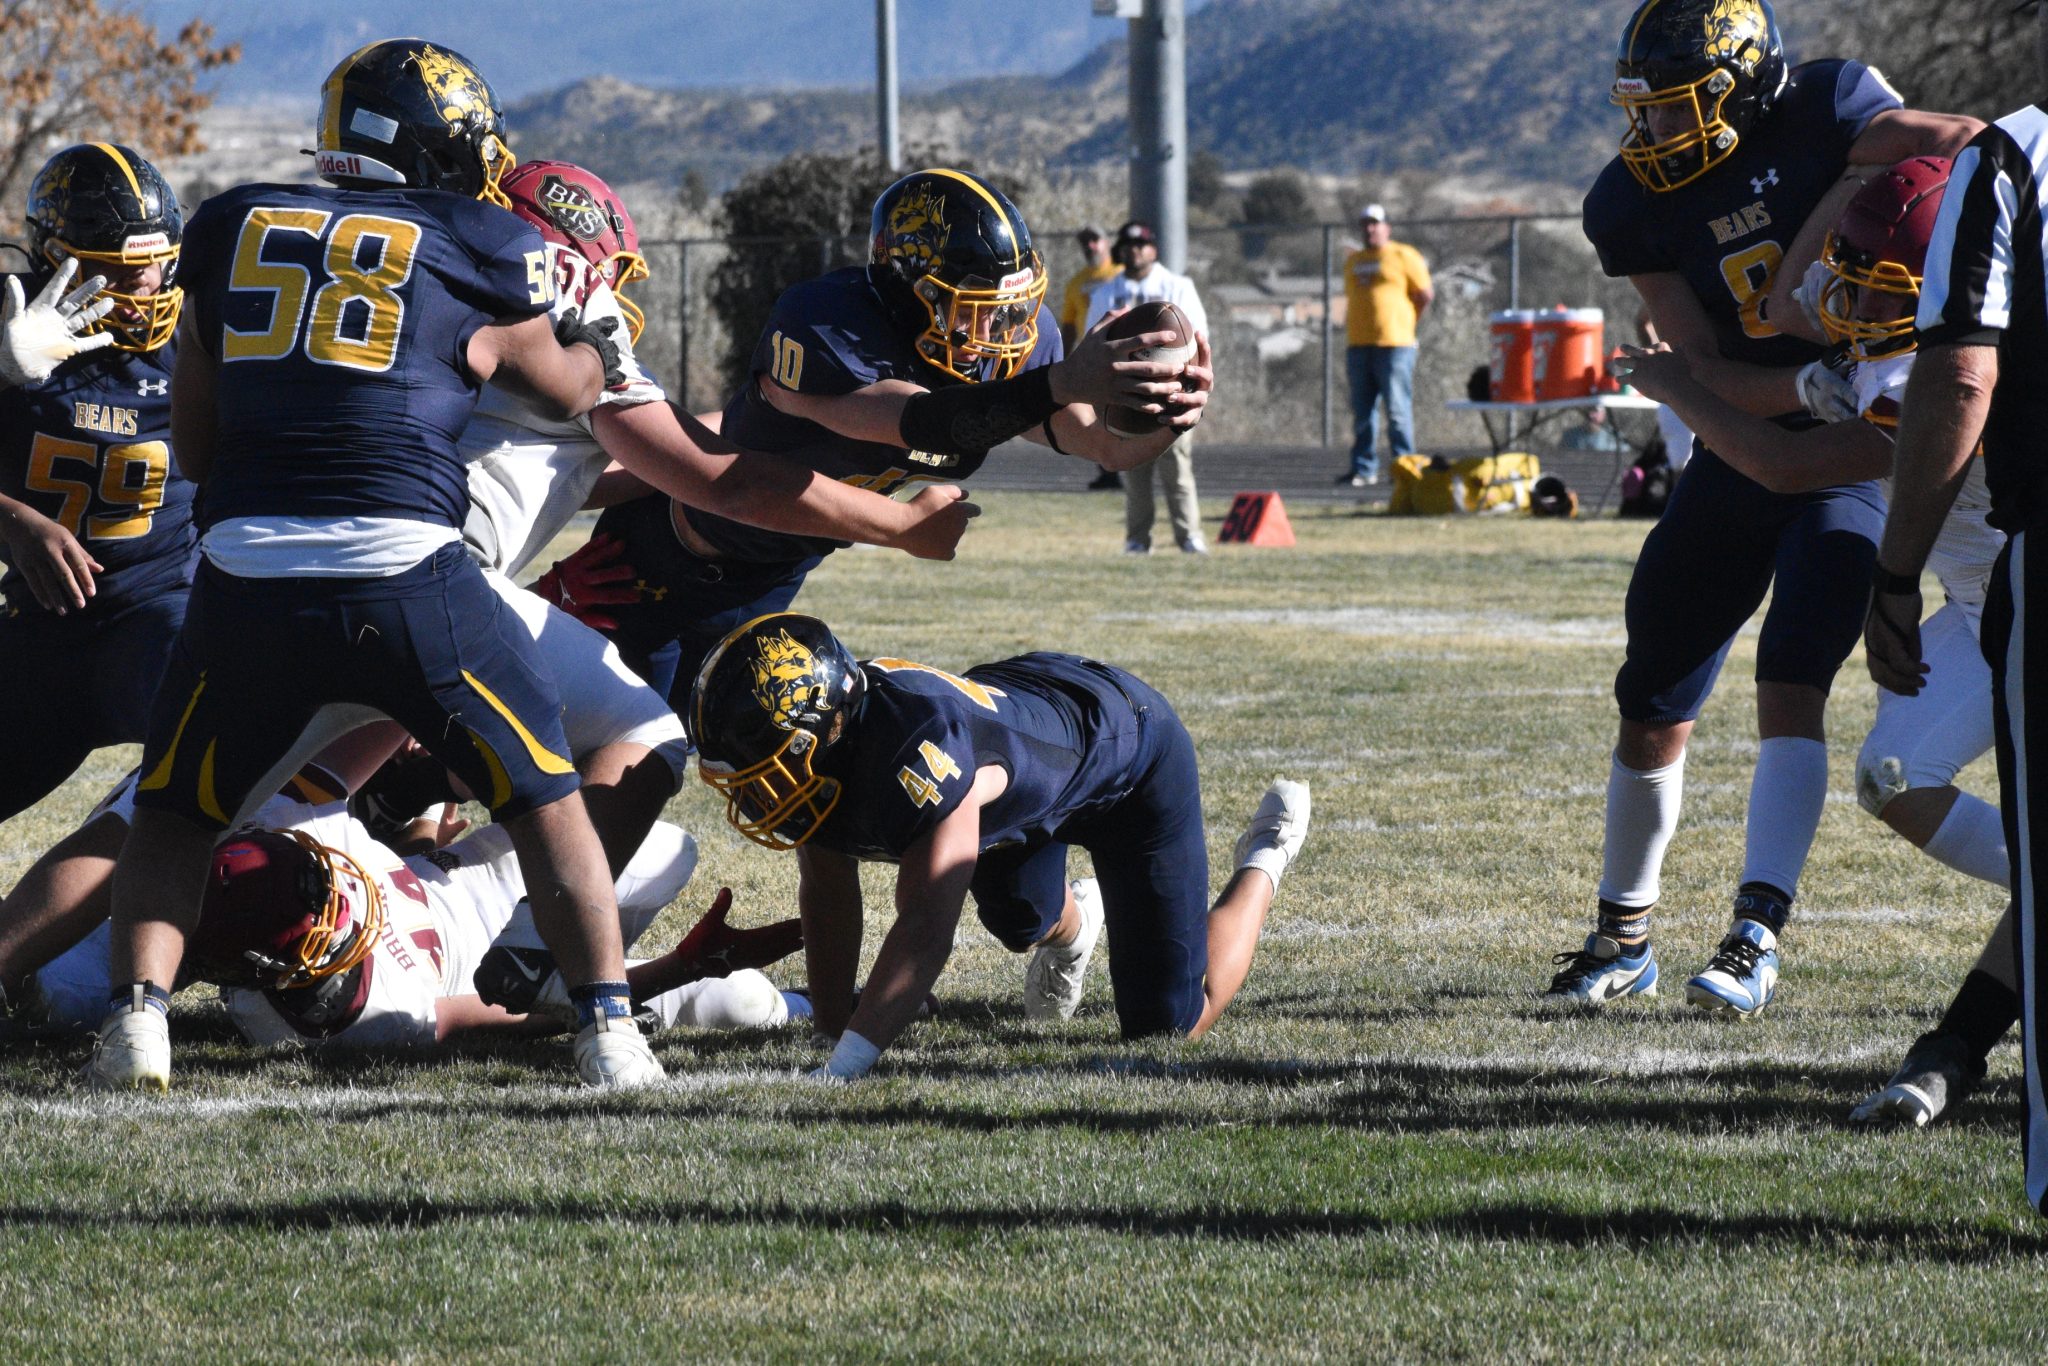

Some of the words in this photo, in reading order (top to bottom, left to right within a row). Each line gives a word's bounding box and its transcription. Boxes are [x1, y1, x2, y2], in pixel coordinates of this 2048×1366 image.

[318, 155, 362, 176] ddell
[1707, 200, 1772, 245] BEARS
[223, 206, 423, 373] 58
[772, 330, 804, 391] 10
[74, 402, 138, 436] BEARS
[25, 431, 170, 541] 59
[897, 739, 962, 808] 44
[375, 881, 417, 973] BRU
